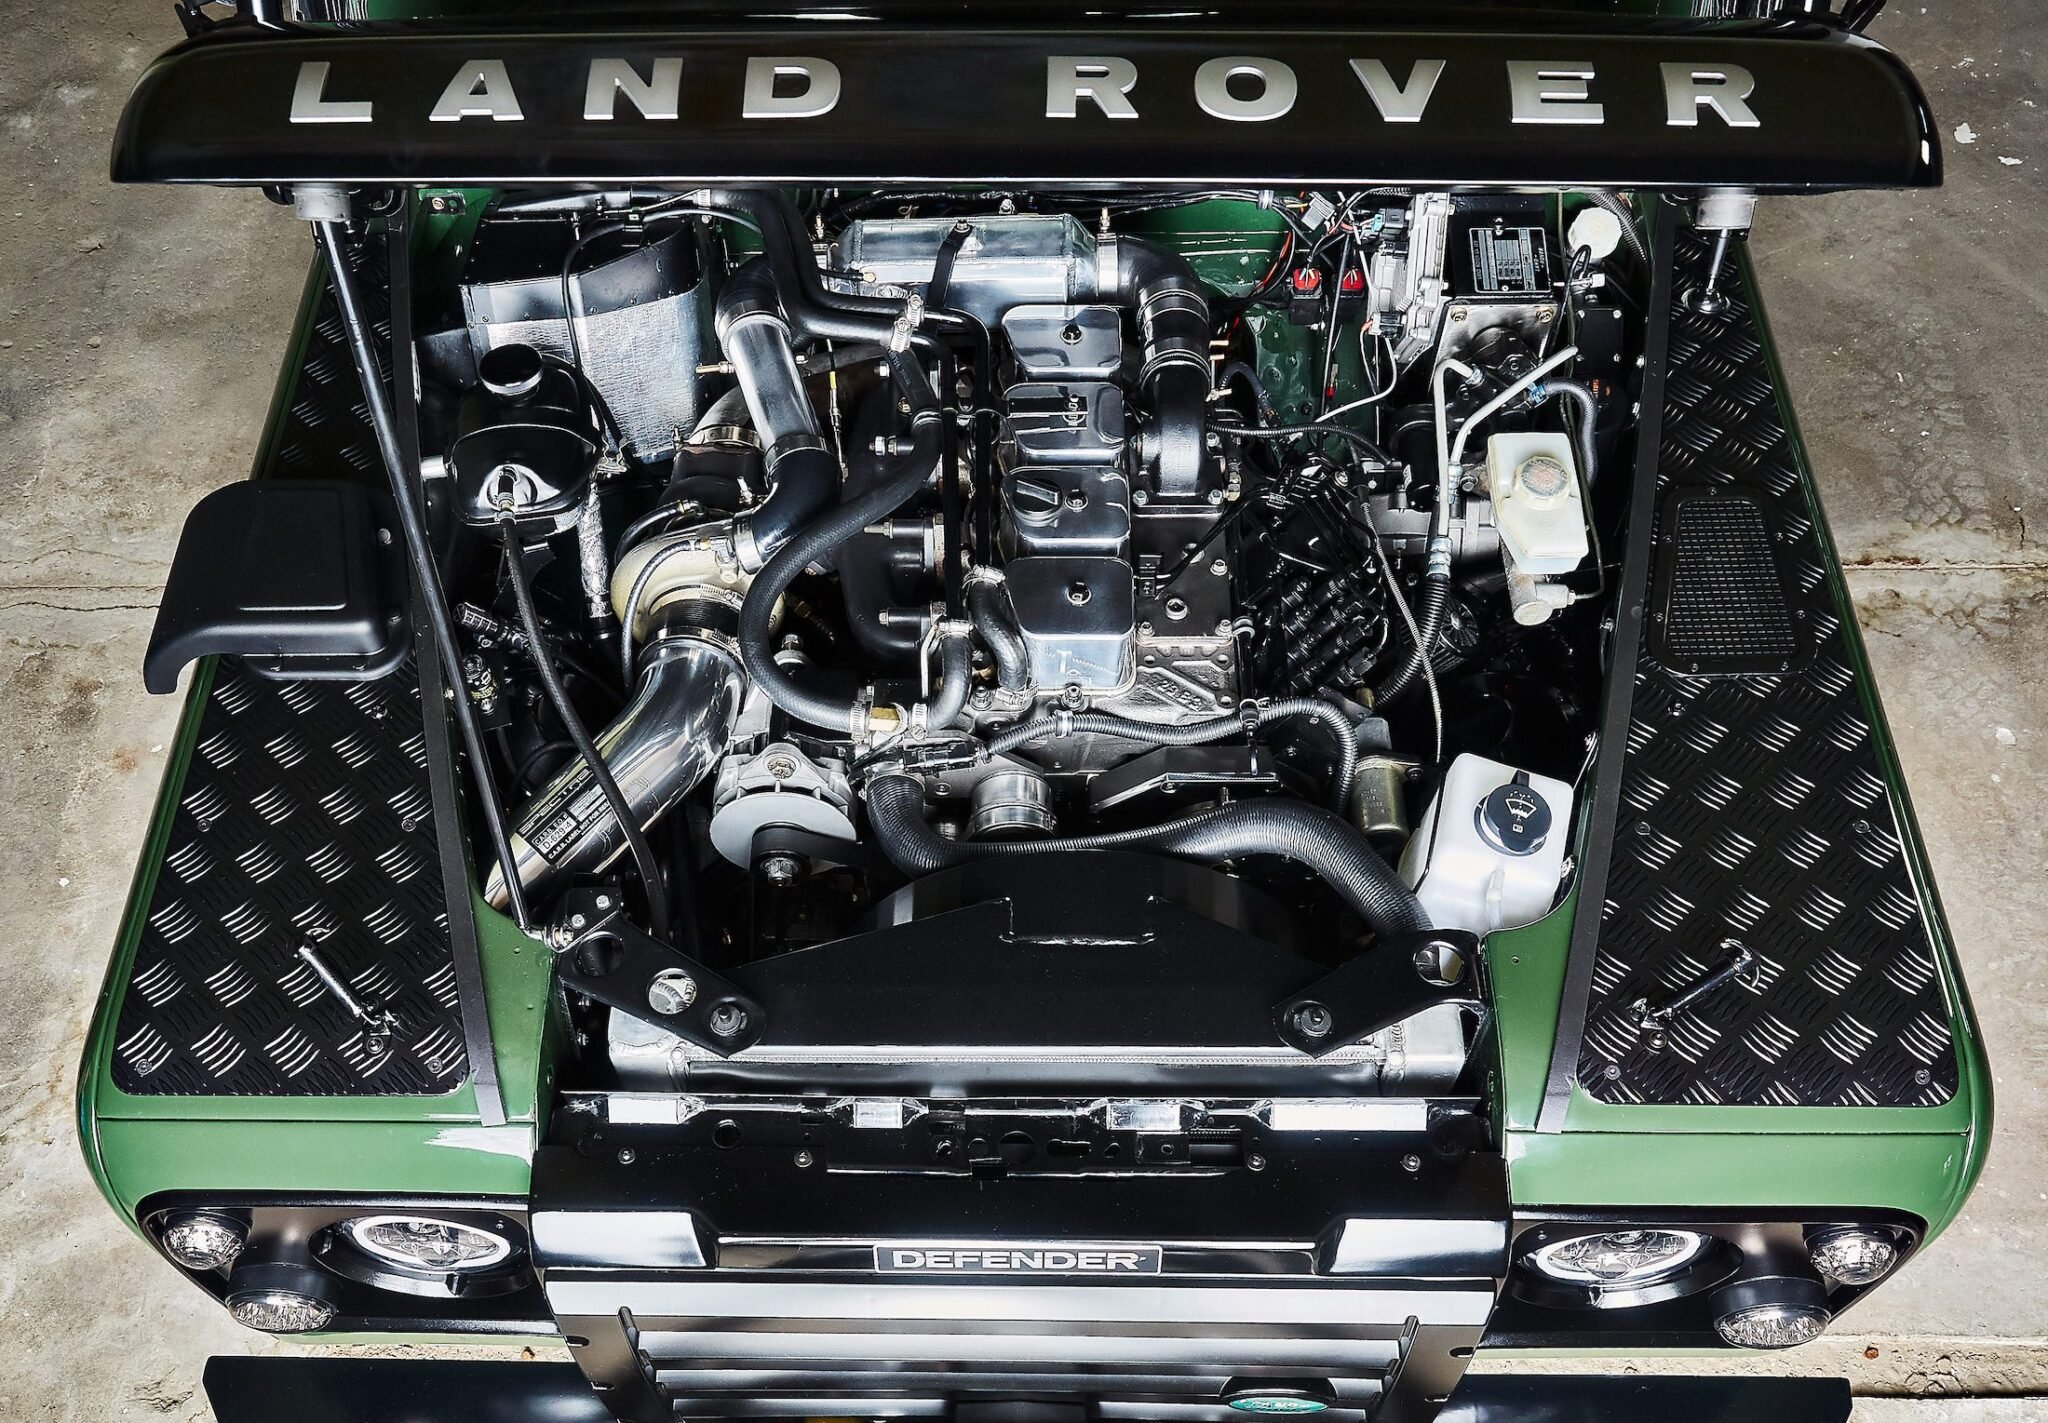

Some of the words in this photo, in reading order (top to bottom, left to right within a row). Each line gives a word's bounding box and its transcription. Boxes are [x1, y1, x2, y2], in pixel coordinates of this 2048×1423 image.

[290, 57, 841, 123] LAND
[1046, 55, 1761, 127] ROVER
[579, 818, 591, 830] NOT
[589, 810, 600, 821] FOR
[542, 821, 573, 850] D-629-4
[893, 1250, 1140, 1270] DEFENDER
